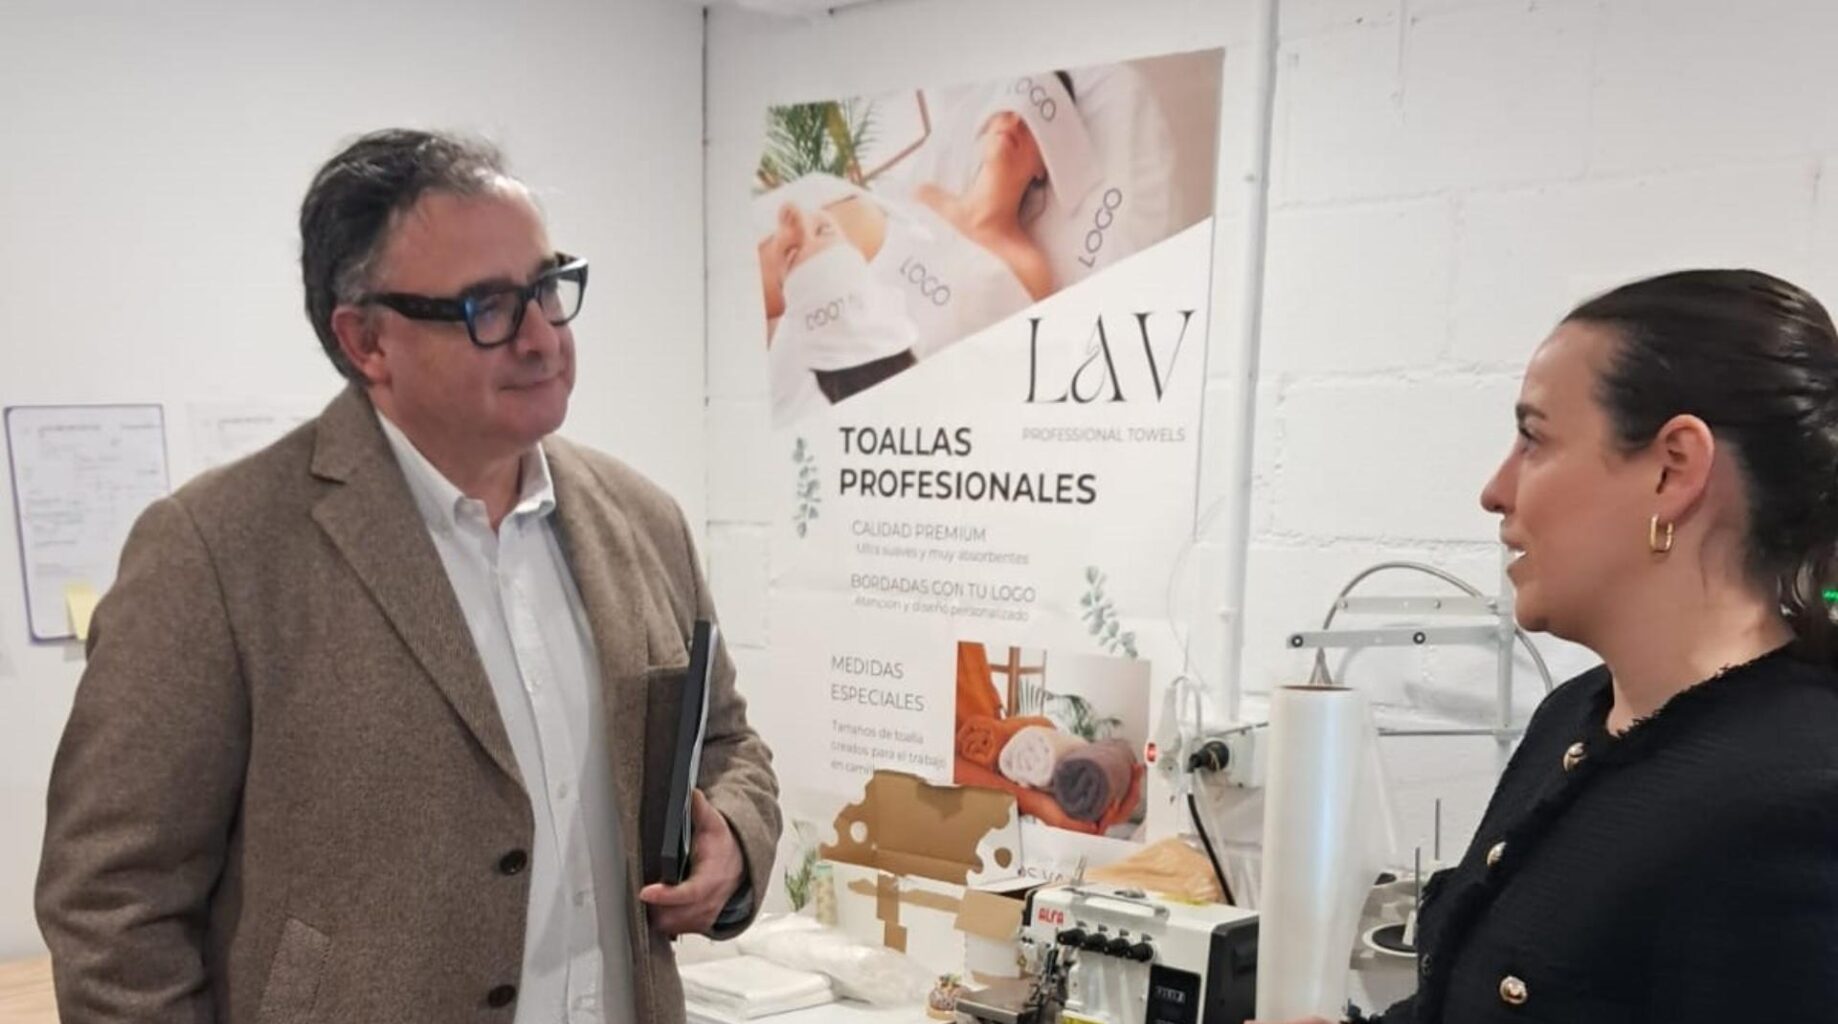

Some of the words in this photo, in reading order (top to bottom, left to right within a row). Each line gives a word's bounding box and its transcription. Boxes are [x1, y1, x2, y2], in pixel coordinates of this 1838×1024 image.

[1078, 187, 1123, 269] LOGO
[900, 254, 951, 307] LOGO
[1024, 310, 1197, 405] LAV
[839, 427, 972, 456] TOALLAS
[1021, 426, 1123, 442] PROFESSIONAL
[1127, 427, 1187, 442] TOWELS
[839, 468, 1098, 504] PROFESIONALES
[851, 519, 913, 538] CALIDAD
[915, 523, 988, 542] PREMIUM
[850, 573, 930, 595] BORDADAS
[931, 580, 964, 598] CON
[967, 583, 987, 600] TU
[991, 585, 1037, 604] LOGO
[831, 655, 905, 679] MEDIDAS
[831, 683, 926, 712] ESPECIALES
[878, 727, 893, 740] de
